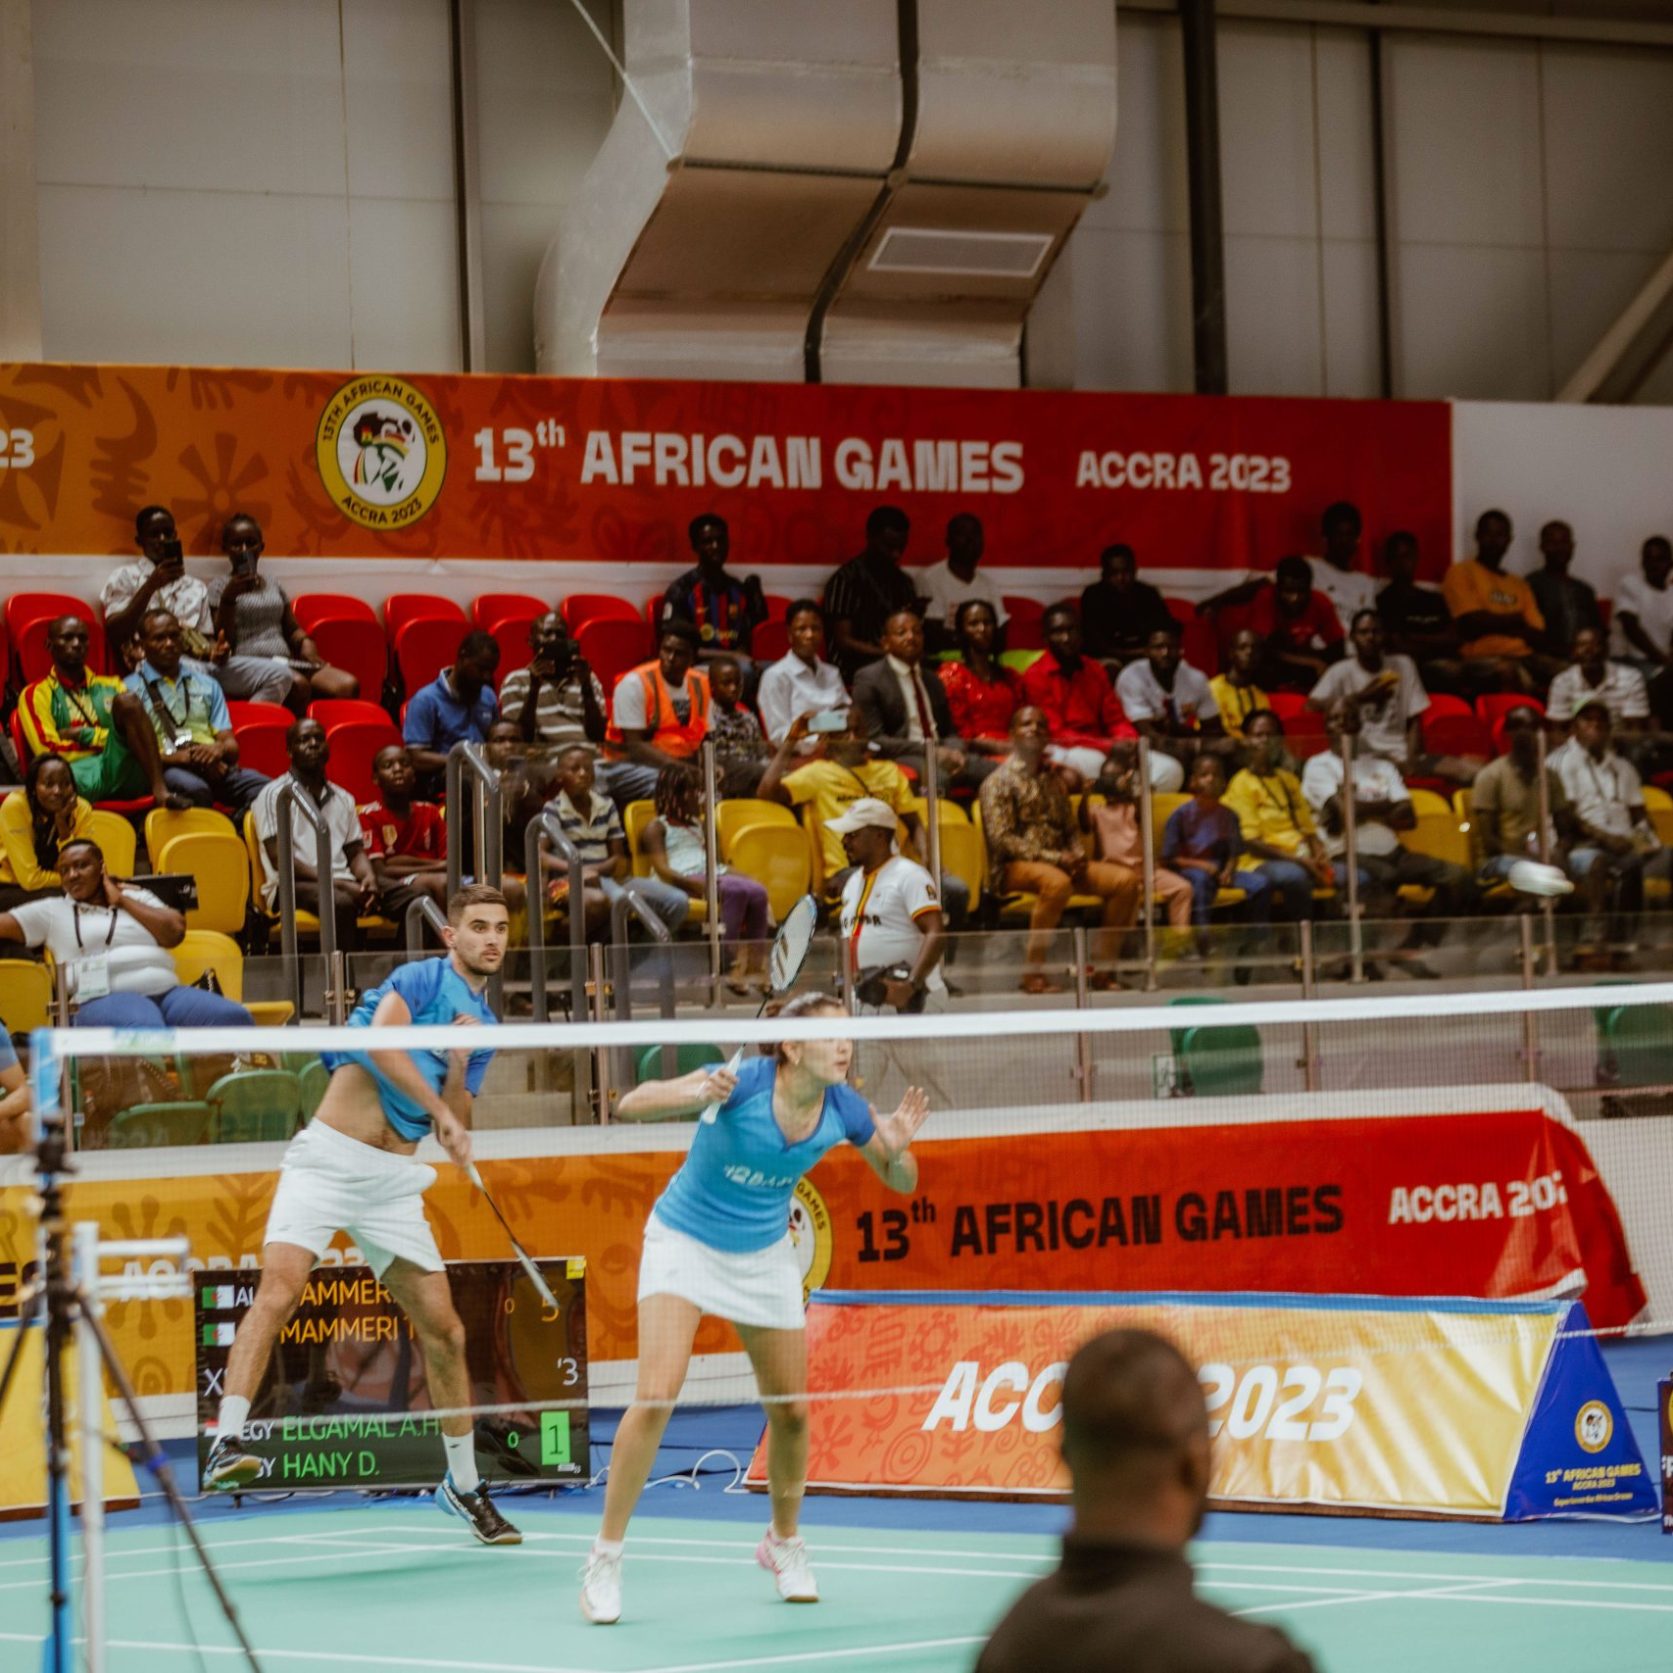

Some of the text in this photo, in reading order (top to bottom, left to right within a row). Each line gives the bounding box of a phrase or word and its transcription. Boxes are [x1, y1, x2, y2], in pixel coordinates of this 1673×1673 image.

[323, 380, 440, 445] 13TH AFRICAN GAMES
[474, 418, 1024, 494] 13th AFRICAN GAMES
[1076, 451, 1291, 493] ACCRA 2023
[341, 496, 422, 524] ACCRA 2023
[796, 1182, 826, 1231] GAMES
[856, 1184, 1345, 1263] 13th AFRICAN GAMES
[1388, 1182, 1503, 1224] ACCRA
[300, 1279, 397, 1307] AMMER
[279, 1316, 398, 1345] MAMMERI
[920, 1361, 1364, 1442] ACC 2023
[282, 1414, 397, 1442] ELGAMAL
[547, 1423, 564, 1456] 1
[283, 1451, 353, 1479] HANY
